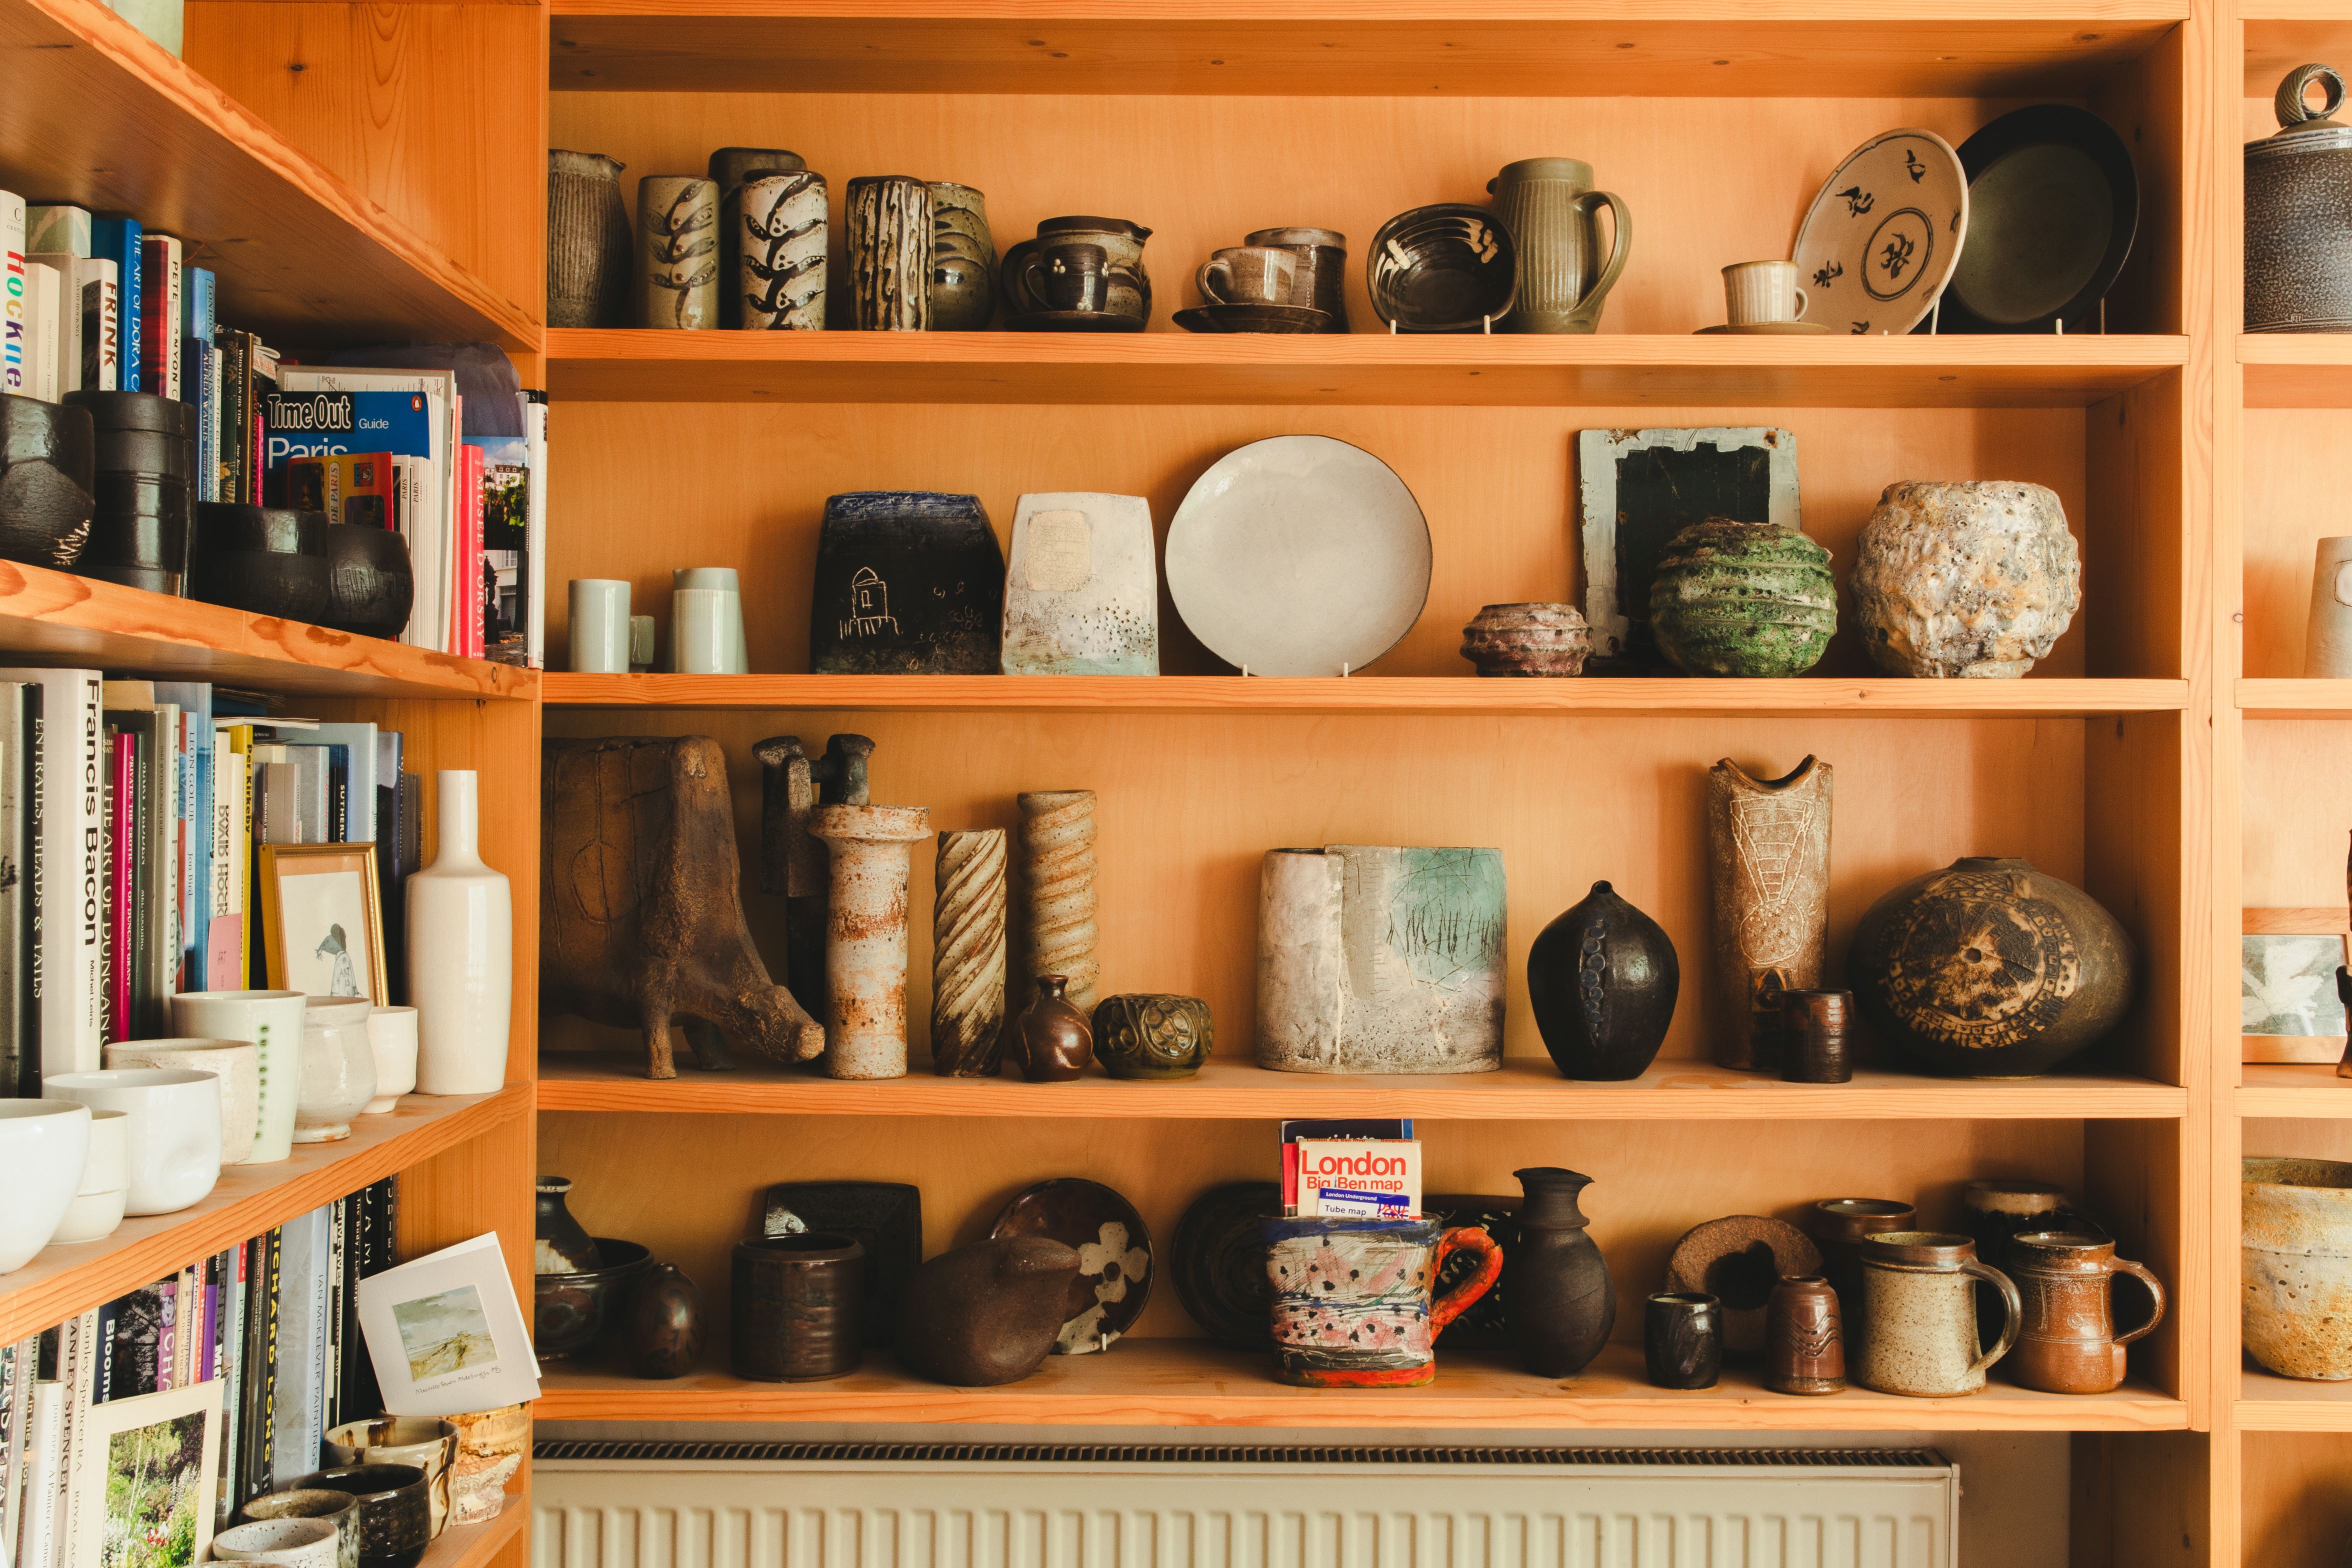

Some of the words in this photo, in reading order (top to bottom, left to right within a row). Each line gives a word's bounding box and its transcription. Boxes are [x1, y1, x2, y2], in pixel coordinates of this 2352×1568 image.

[134, 233, 142, 260] THE
[132, 262, 141, 290] ART
[104, 282, 117, 369] FRINK
[132, 295, 140, 314] OF
[131, 317, 140, 368] DORA
[268, 394, 313, 428] Time
[314, 394, 352, 429] Out
[358, 418, 390, 429] Guide
[330, 467, 338, 502] PARIS
[476, 552, 484, 640] D'ORSAY
[86, 678, 99, 816] Francis
[32, 718, 44, 825] ENTRAILS,
[104, 780, 114, 828] THE
[34, 834, 44, 908] HEADS
[103, 833, 114, 881] ART
[85, 826, 98, 946] Bacon
[102, 886, 112, 914] OF
[127, 890, 132, 904] OF
[34, 916, 43, 932] &
[169, 839, 178, 985] Fontana
[34, 942, 43, 998] TAILS
[101, 921, 112, 1032] DUNCAN
[1302, 1150, 1406, 1175] London
[1306, 1176, 1331, 1190] Big
[1338, 1176, 1368, 1190] Ben
[1370, 1180, 1404, 1192] map
[1324, 1204, 1346, 1214] Tube
[1348, 1208, 1366, 1216] map
[1326, 1191, 1344, 1199] London
[1345, 1193, 1378, 1201] Underground
[269, 1224, 280, 1364] RICHARD
[82, 1314, 94, 1374] Stanley
[102, 1318, 116, 1404] Blooms
[18, 1363, 30, 1418] PIPER
[28, 1360, 38, 1395] Piper
[27, 1399, 34, 1413] in
[78, 1378, 90, 1444] Spencer
[264, 1376, 274, 1462] LONG
[312, 1386, 320, 1466] PAINTINGS
[22, 1446, 32, 1486] 1930s
[60, 1400, 74, 1497] SPENCER
[76, 1449, 84, 1473] RA
[48, 1470, 56, 1478] A
[45, 1482, 54, 1529] Painter's
[72, 1490, 80, 1535] ROYAL
